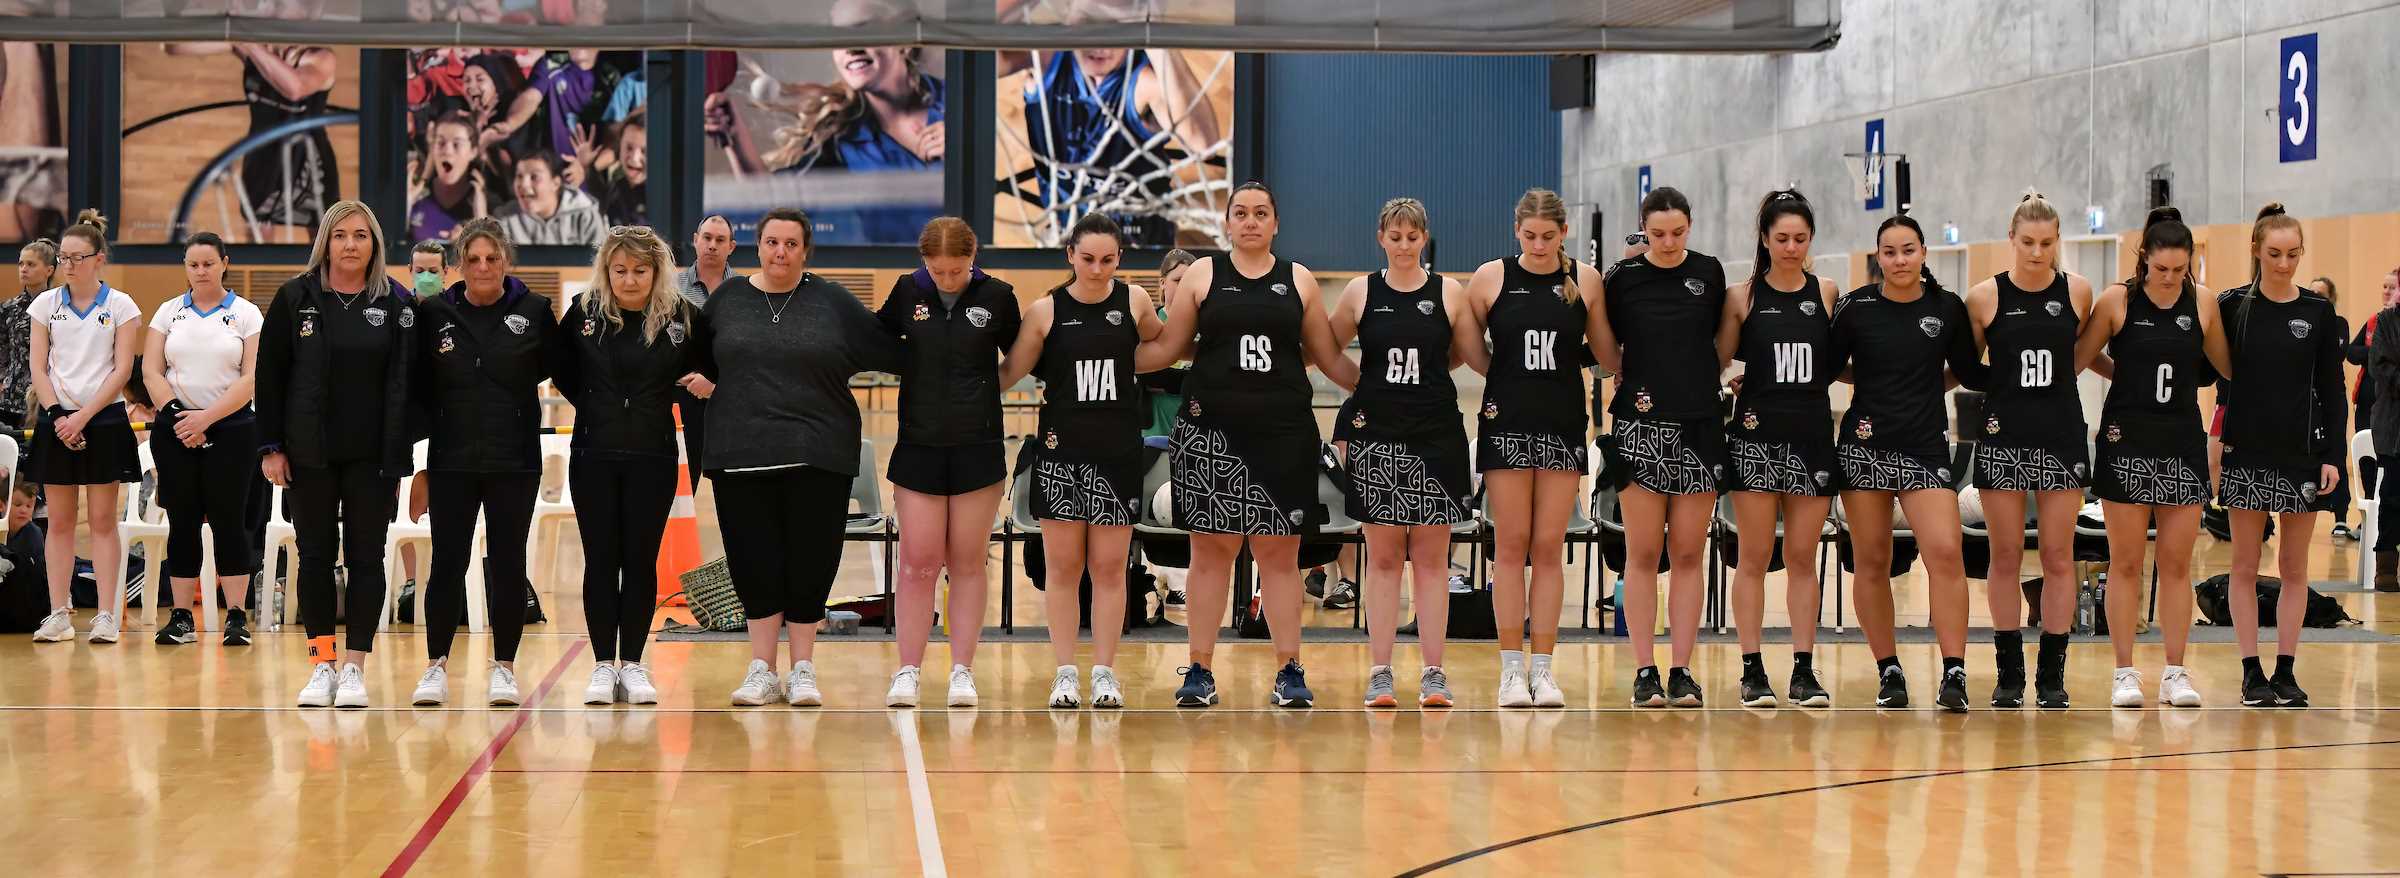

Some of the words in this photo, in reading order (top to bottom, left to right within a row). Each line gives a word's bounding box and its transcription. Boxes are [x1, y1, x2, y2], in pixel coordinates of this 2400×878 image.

[2287, 50, 2309, 146] 3
[1240, 334, 1272, 372] GS
[1385, 347, 1420, 384] GA
[1524, 329, 1557, 370] GK
[1773, 342, 1812, 383] WD
[2020, 349, 2053, 387] GD
[1075, 359, 1117, 402] WA
[2156, 363, 2173, 403] C
